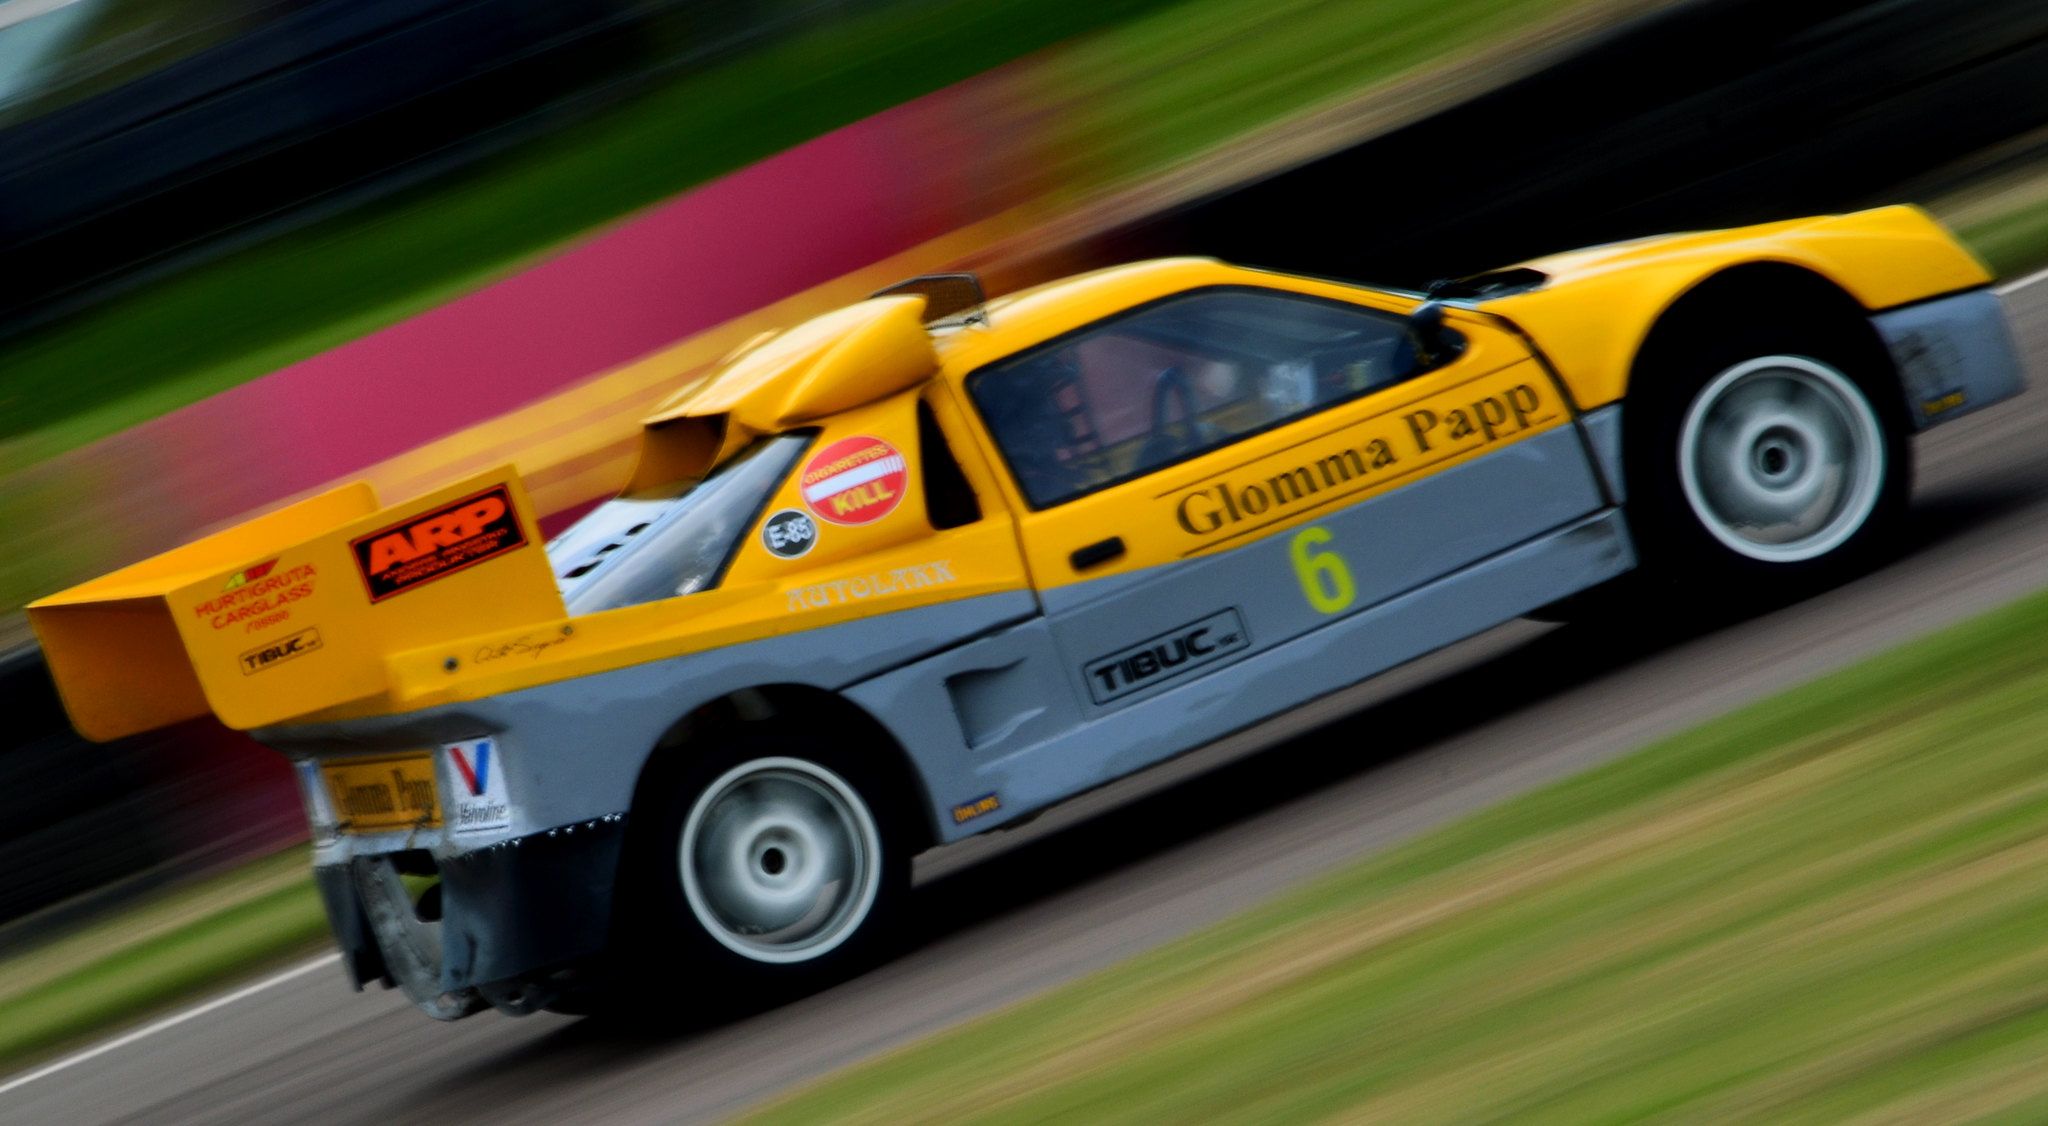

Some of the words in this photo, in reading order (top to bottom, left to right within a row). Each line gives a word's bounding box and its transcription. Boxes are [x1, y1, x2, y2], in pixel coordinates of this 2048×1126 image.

[1176, 438, 1398, 536] Glomma
[1402, 383, 1541, 454] Papp
[828, 478, 896, 516] KILL
[369, 496, 506, 577] ARP
[768, 515, 812, 549] E-85
[194, 563, 317, 618] HURTIGRUTA
[785, 559, 958, 613] AUTOLAKK
[1289, 525, 1358, 616] 6
[211, 583, 313, 630] CARGLASS
[244, 636, 304, 669] TIBUC
[1094, 627, 1216, 691] TIBUC
